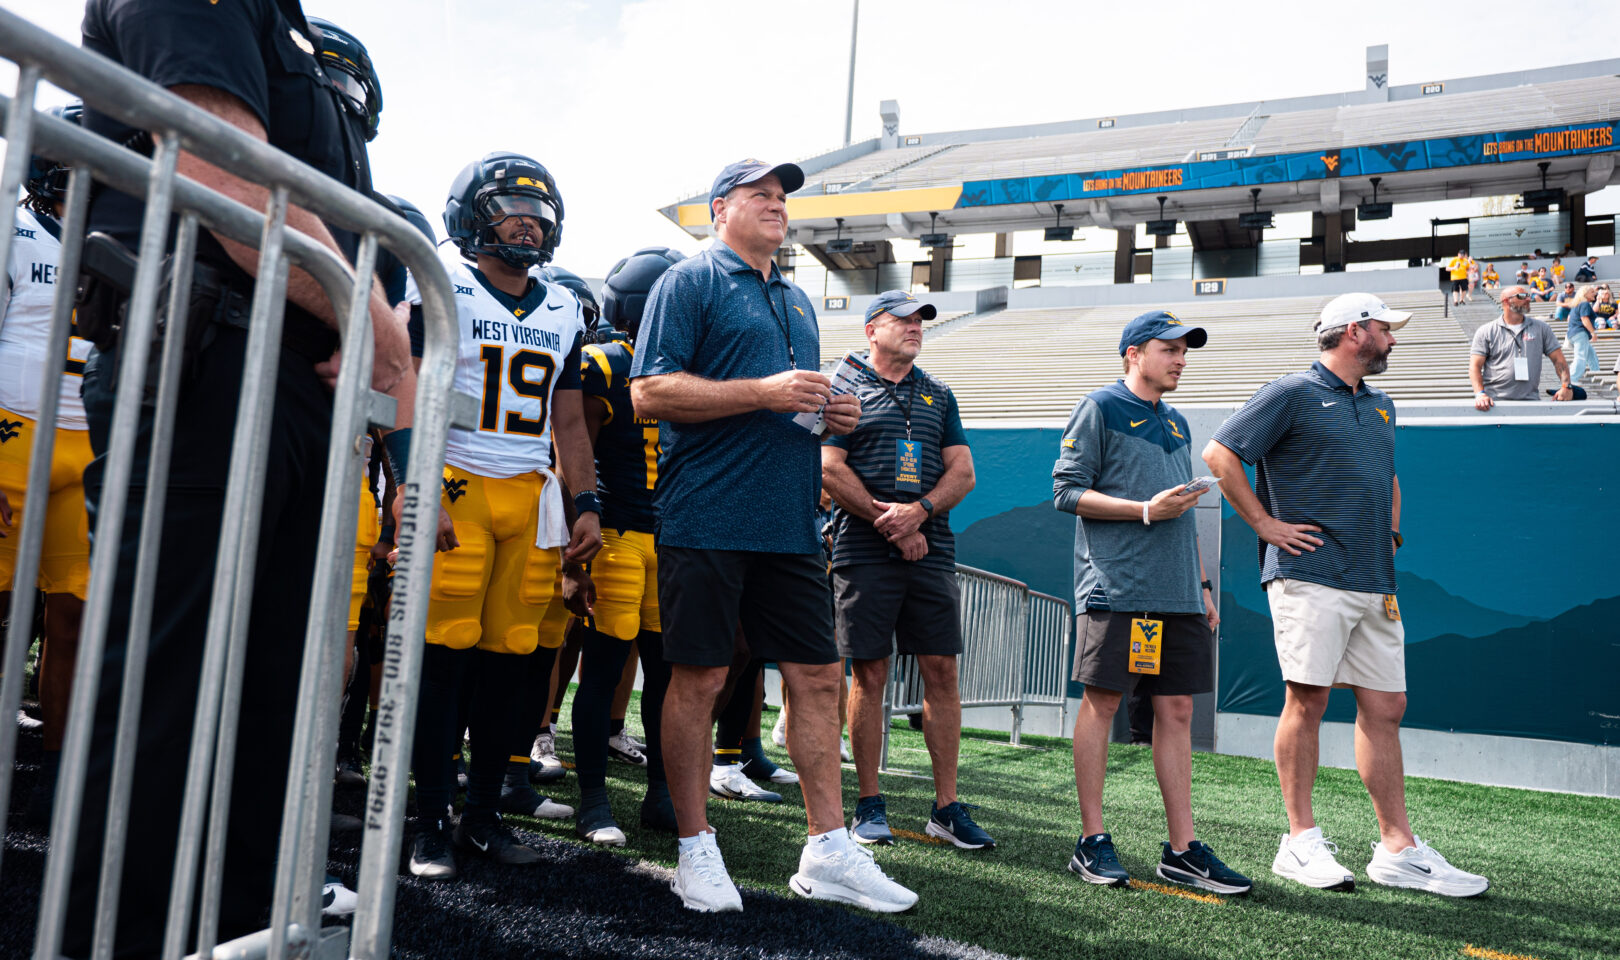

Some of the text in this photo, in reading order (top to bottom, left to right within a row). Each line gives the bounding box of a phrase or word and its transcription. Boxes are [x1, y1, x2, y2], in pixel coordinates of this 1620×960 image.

[1498, 140, 1515, 154] BRING
[1515, 139, 1524, 152] ON
[1524, 138, 1534, 151] THE
[1534, 126, 1613, 153] MOUNTAINEERS
[1122, 168, 1183, 191] MOUNTAINEERS
[1200, 282, 1219, 293] 129
[828, 299, 844, 309] 130
[472, 319, 561, 353] WEST VIRGINIA
[479, 343, 557, 438] 19
[390, 483, 420, 622] FRIEDRICHS
